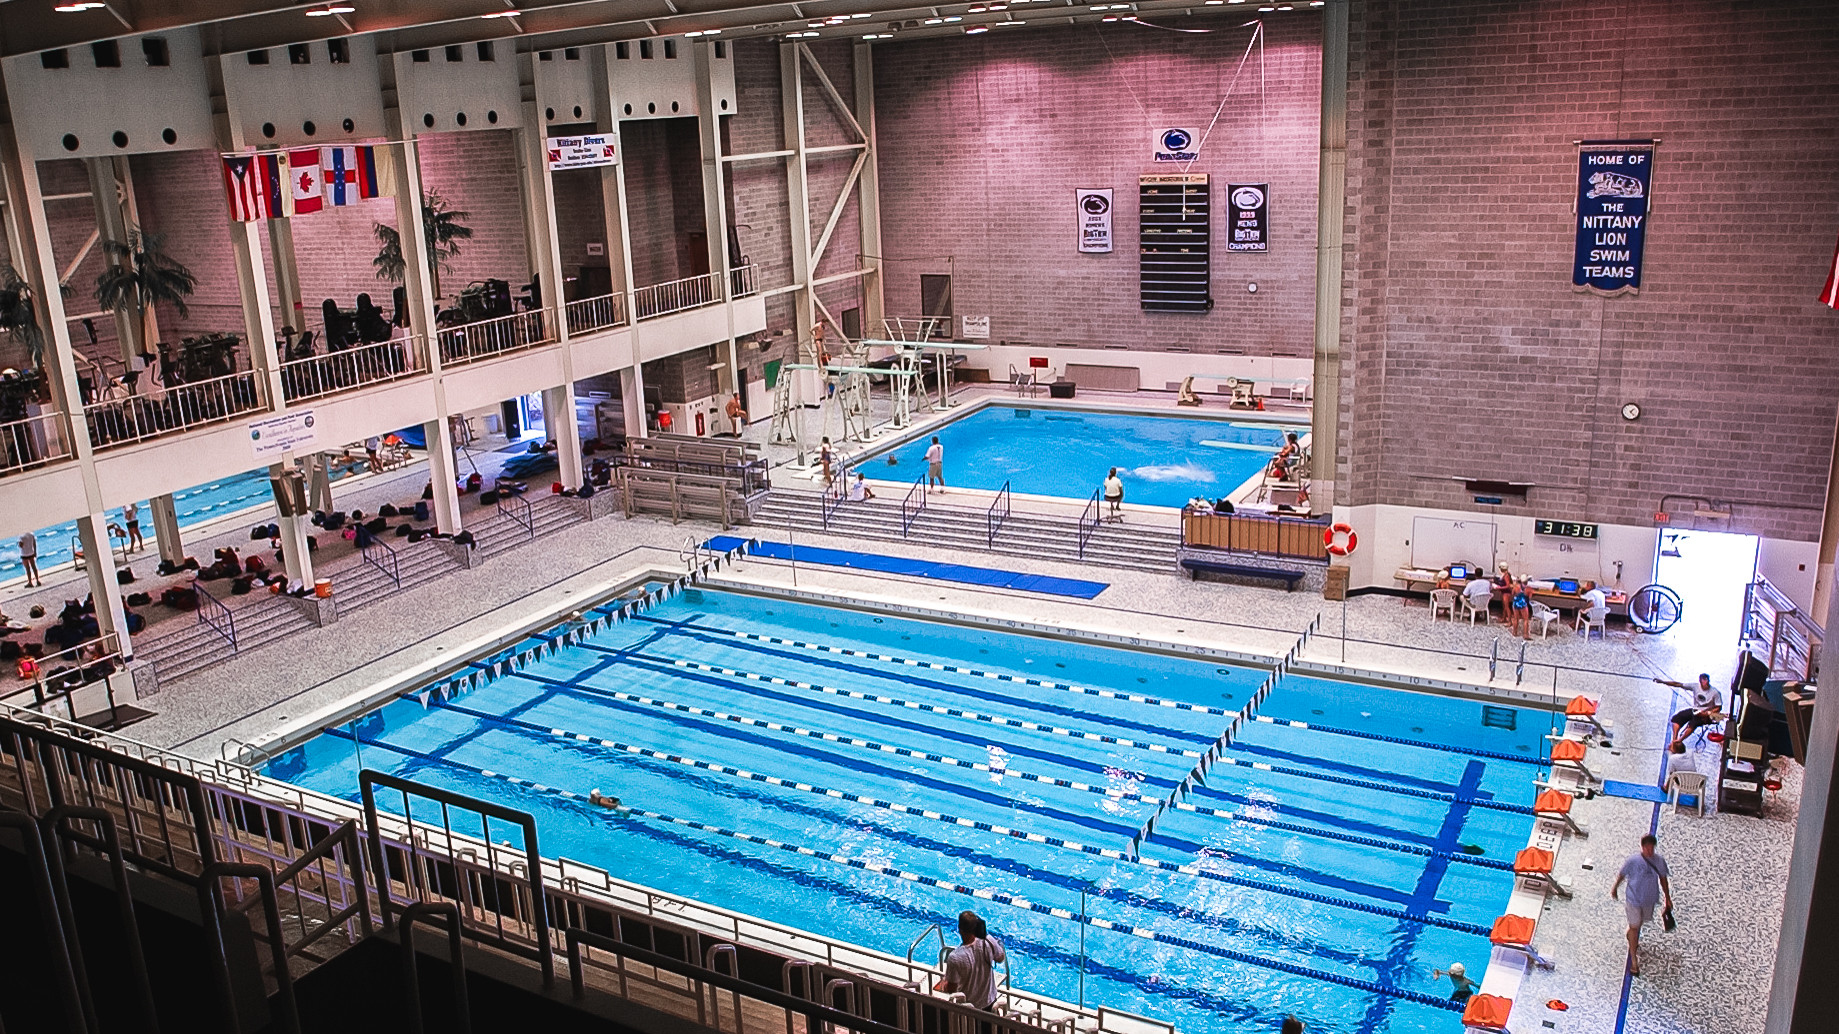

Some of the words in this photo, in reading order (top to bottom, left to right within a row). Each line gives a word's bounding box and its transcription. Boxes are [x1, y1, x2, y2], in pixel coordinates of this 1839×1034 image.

[1588, 155, 1624, 165] HOME
[1628, 155, 1645, 165] OF
[1601, 203, 1624, 213] THE
[1582, 215, 1643, 229] NITTANY
[1595, 232, 1627, 246] LION
[1589, 249, 1630, 262] SWIM
[1582, 266, 1635, 278] TEAMS
[1334, 665, 1345, 674] 15
[1409, 676, 1420, 685] 10
